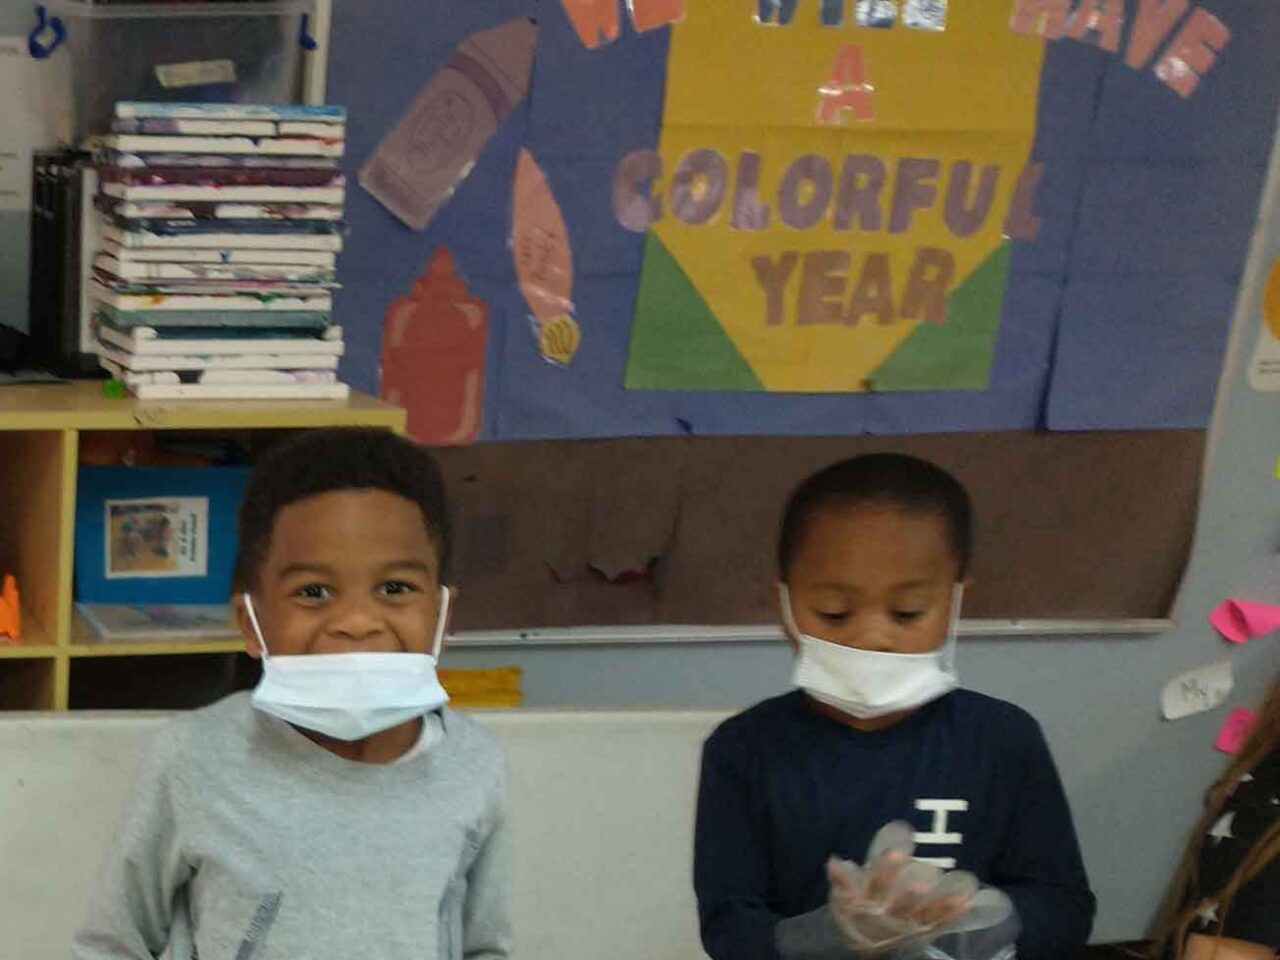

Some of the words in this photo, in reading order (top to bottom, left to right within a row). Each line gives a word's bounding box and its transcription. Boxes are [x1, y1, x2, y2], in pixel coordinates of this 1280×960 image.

[816, 43, 875, 123] A
[614, 149, 1044, 242] COLORFUL
[751, 246, 957, 327] YEAR
